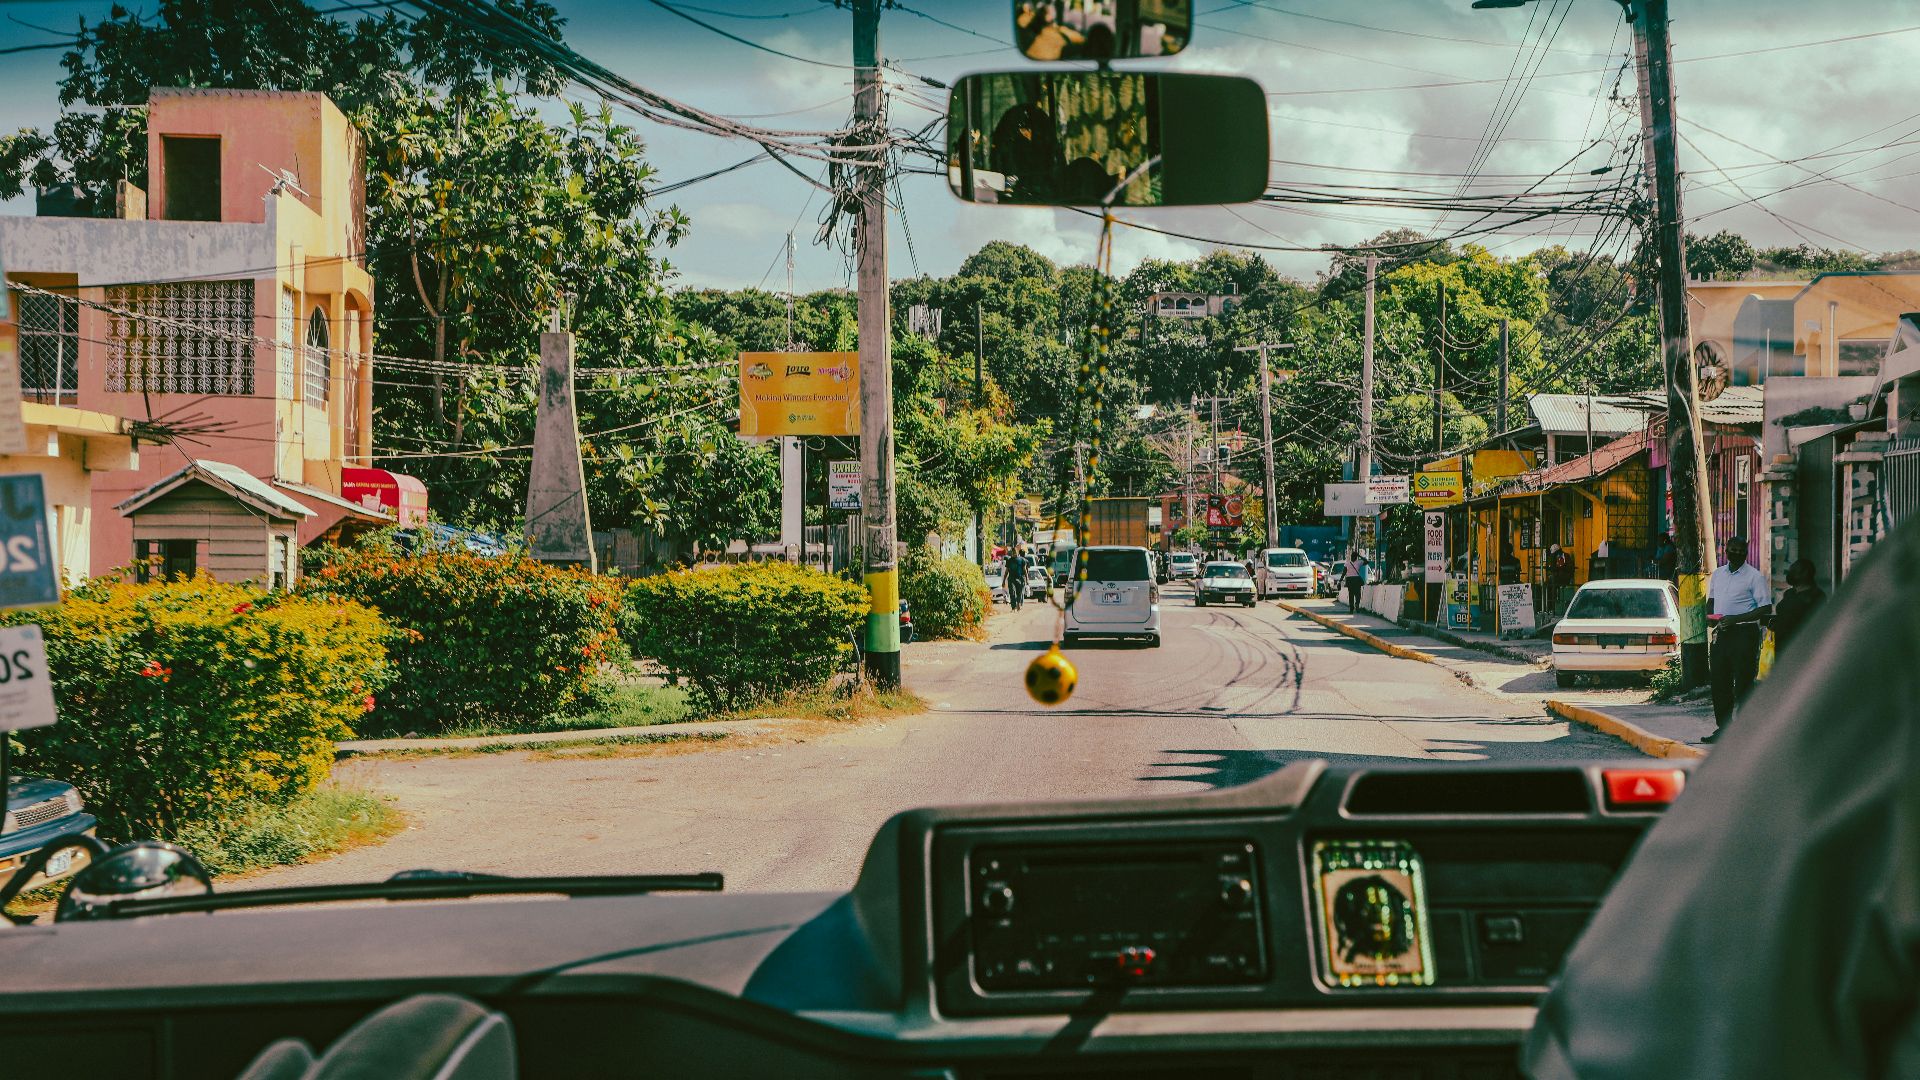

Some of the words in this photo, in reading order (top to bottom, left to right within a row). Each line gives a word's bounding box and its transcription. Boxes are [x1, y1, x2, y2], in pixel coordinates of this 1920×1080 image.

[755, 393, 782, 403] Making
[783, 393, 812, 402] Winners
[1427, 530, 1443, 538] FOOD
